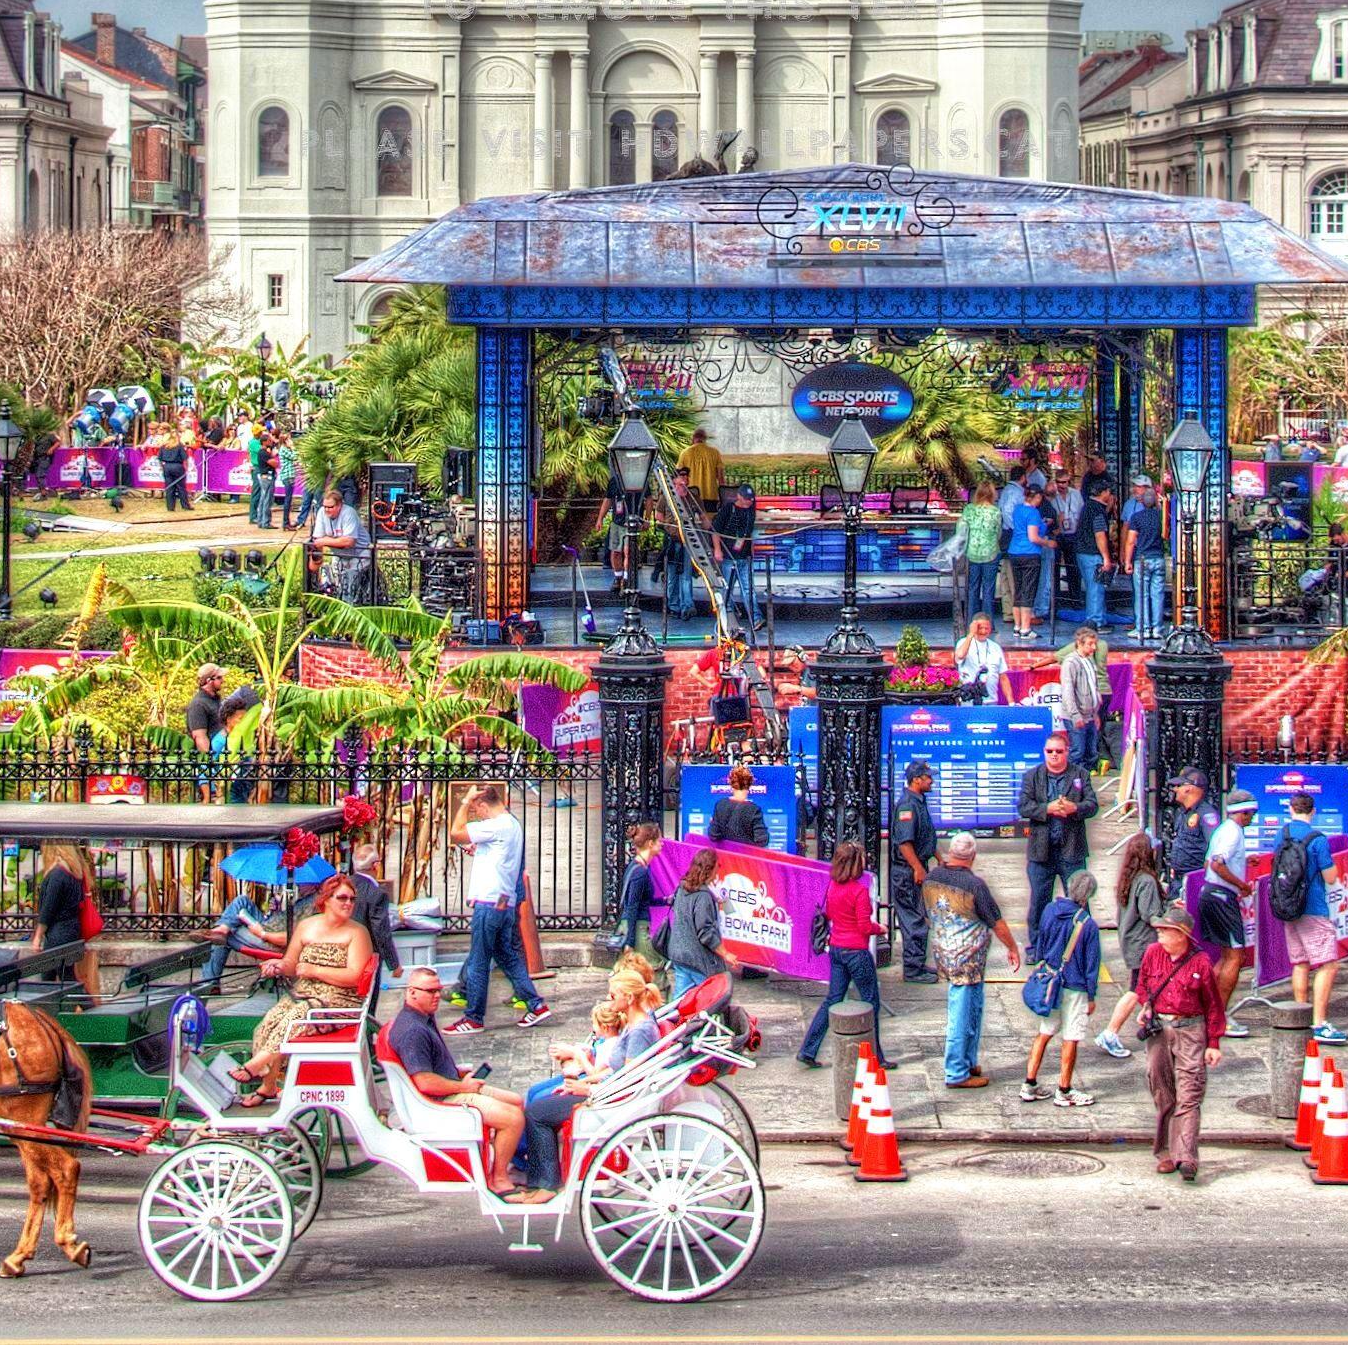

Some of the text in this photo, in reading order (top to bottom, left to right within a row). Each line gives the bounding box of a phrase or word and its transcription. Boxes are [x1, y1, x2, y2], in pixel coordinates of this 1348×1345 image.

[806, 204, 908, 232] XLVII
[846, 239, 882, 251] CBS
[825, 407, 880, 416] NETORK
[729, 889, 757, 906] CBS
[725, 917, 789, 941] BOWL PARK
[300, 1090, 345, 1103] CPNC 1899
